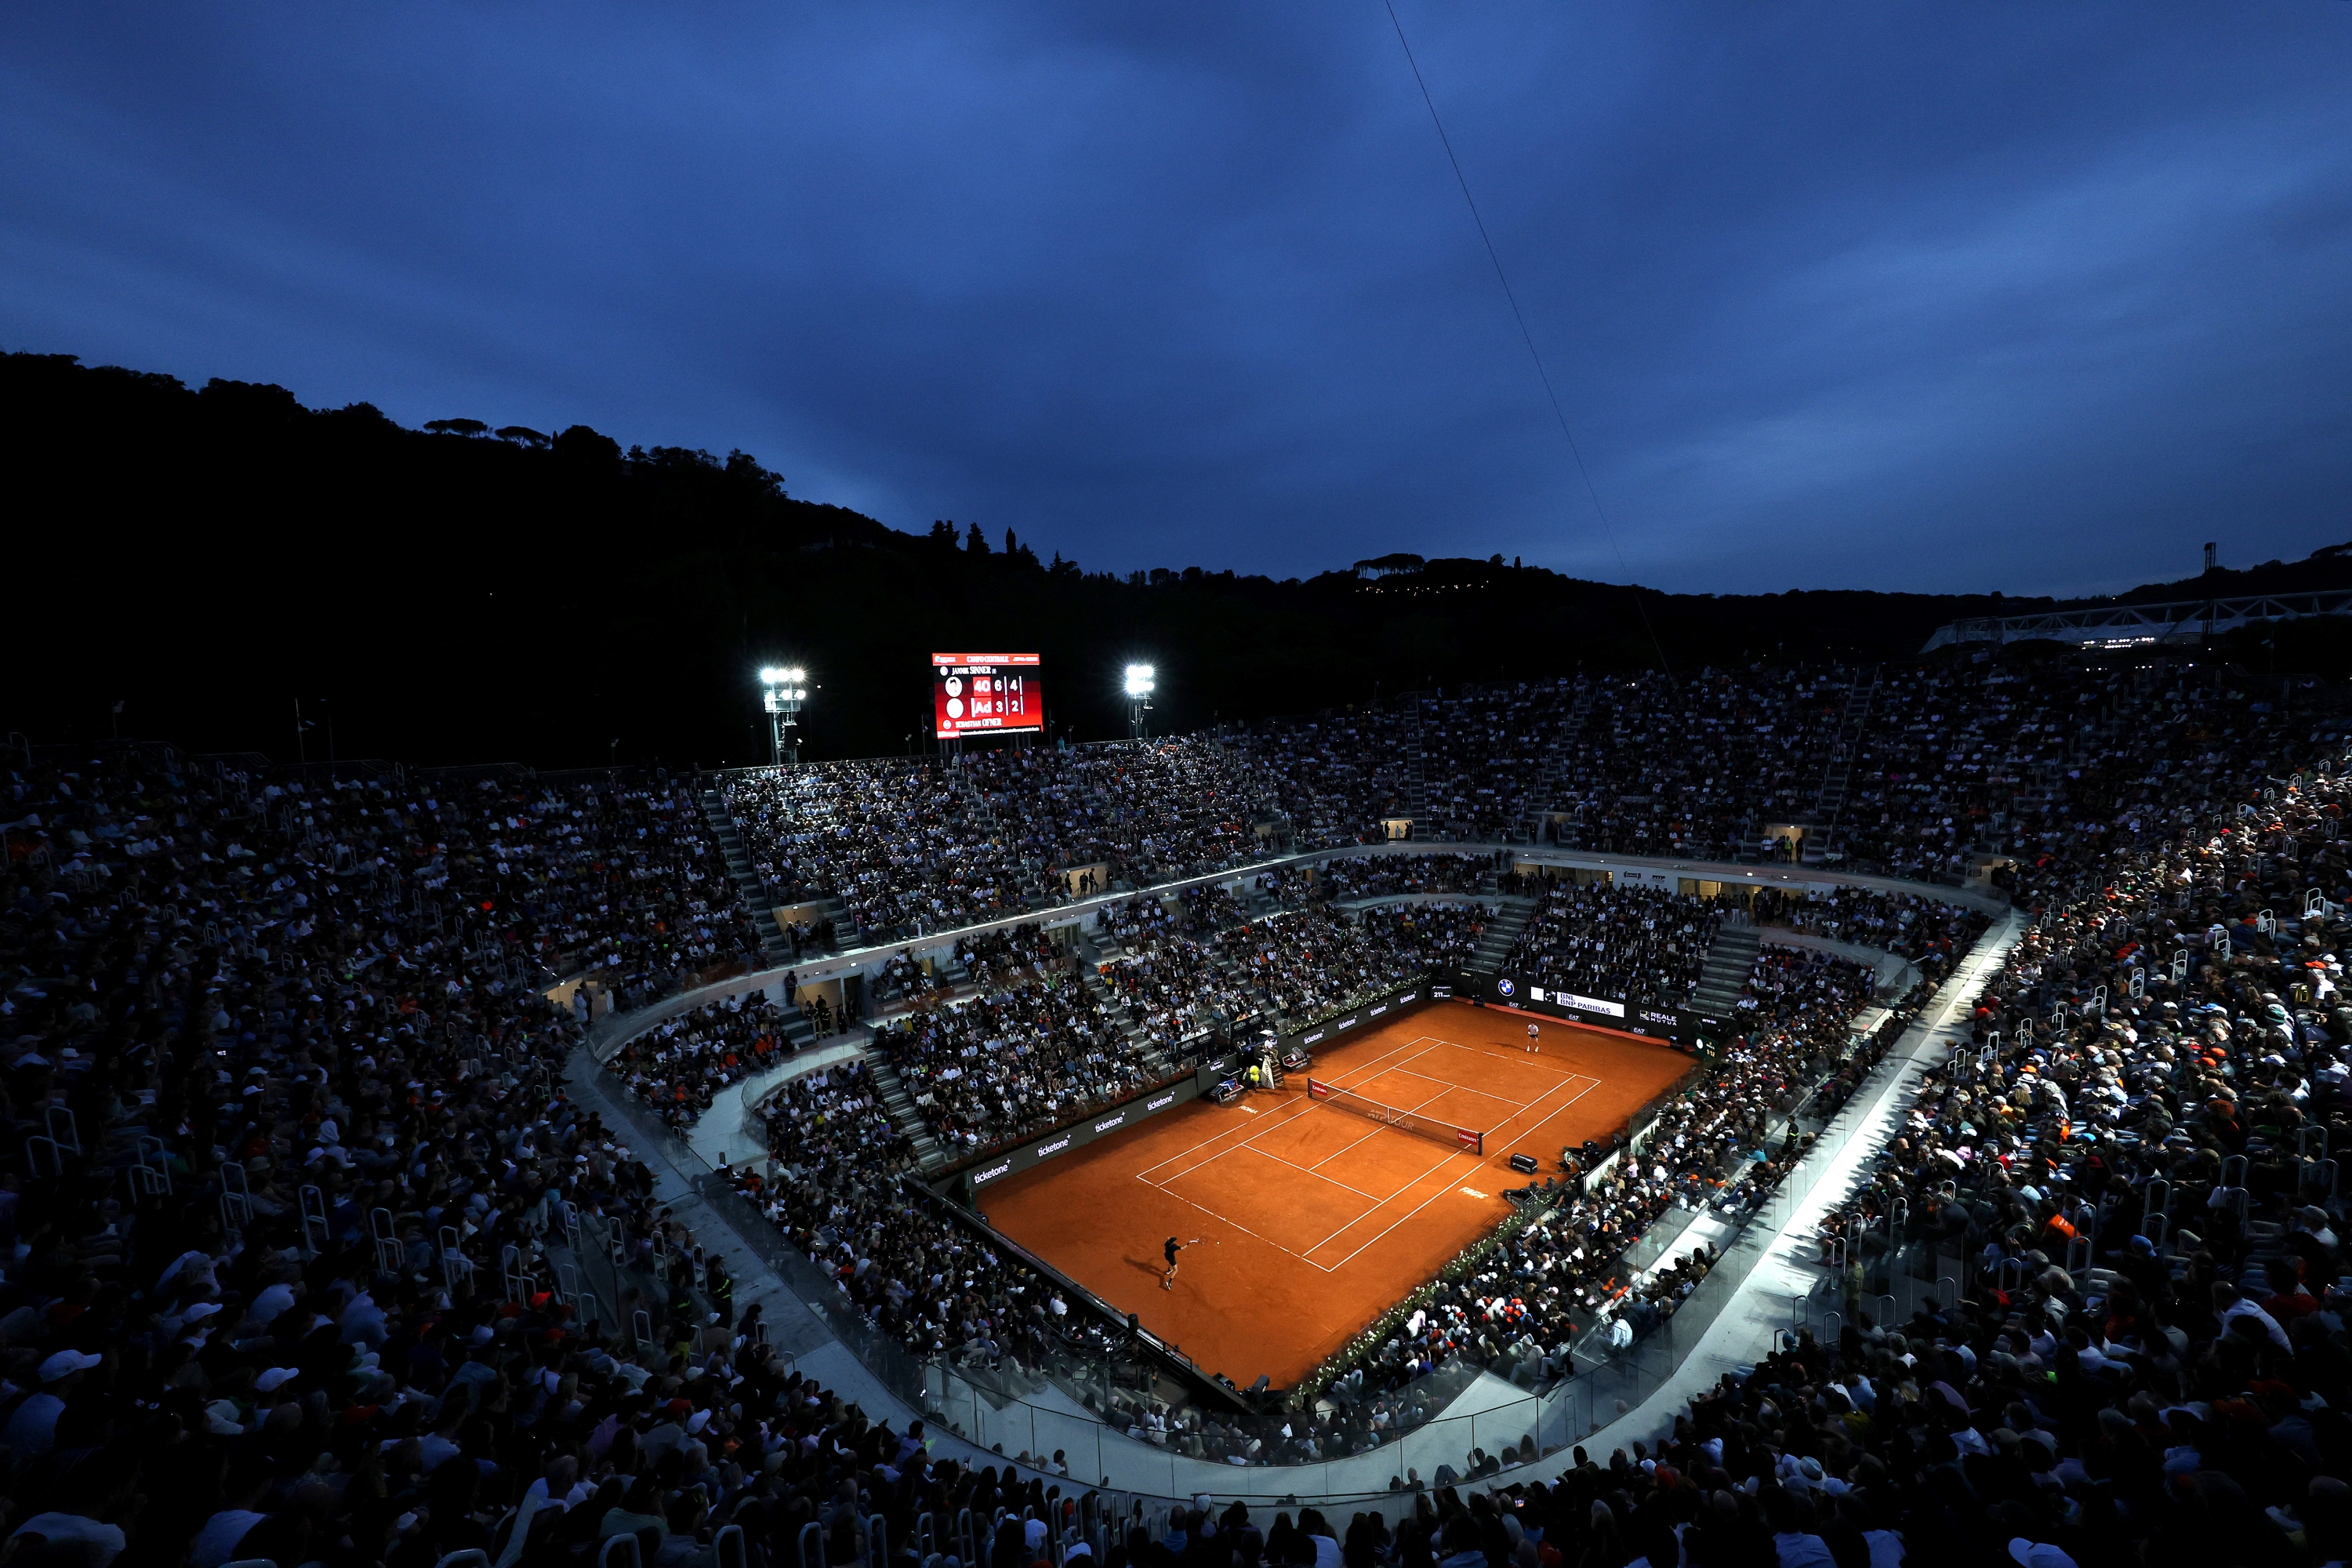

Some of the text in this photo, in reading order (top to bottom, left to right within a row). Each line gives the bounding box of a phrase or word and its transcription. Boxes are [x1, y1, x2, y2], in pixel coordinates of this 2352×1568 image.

[974, 680, 1018, 692] 40 6 4
[975, 701, 1018, 713] Ad 3 2
[1400, 994, 1415, 1004] ticketone
[1370, 1006, 1386, 1016] ticketone
[1577, 1003, 1611, 1014] PARIBAS
[1650, 1012, 1677, 1022] REALE
[1650, 1018, 1677, 1026] MUTUA
[1338, 1018, 1356, 1030] ticketone
[1304, 1032, 1323, 1044] ticketone
[1312, 1085, 1327, 1094] Emirates
[1147, 1094, 1172, 1111] ticketone
[1239, 1105, 1258, 1114] ROMA
[1095, 1115, 1123, 1133] ticketone
[1391, 1116, 1414, 1131] TOUR
[1458, 1133, 1477, 1143] Emirates
[1038, 1138, 1069, 1157] ticketone
[974, 1163, 1007, 1184] ticketone
